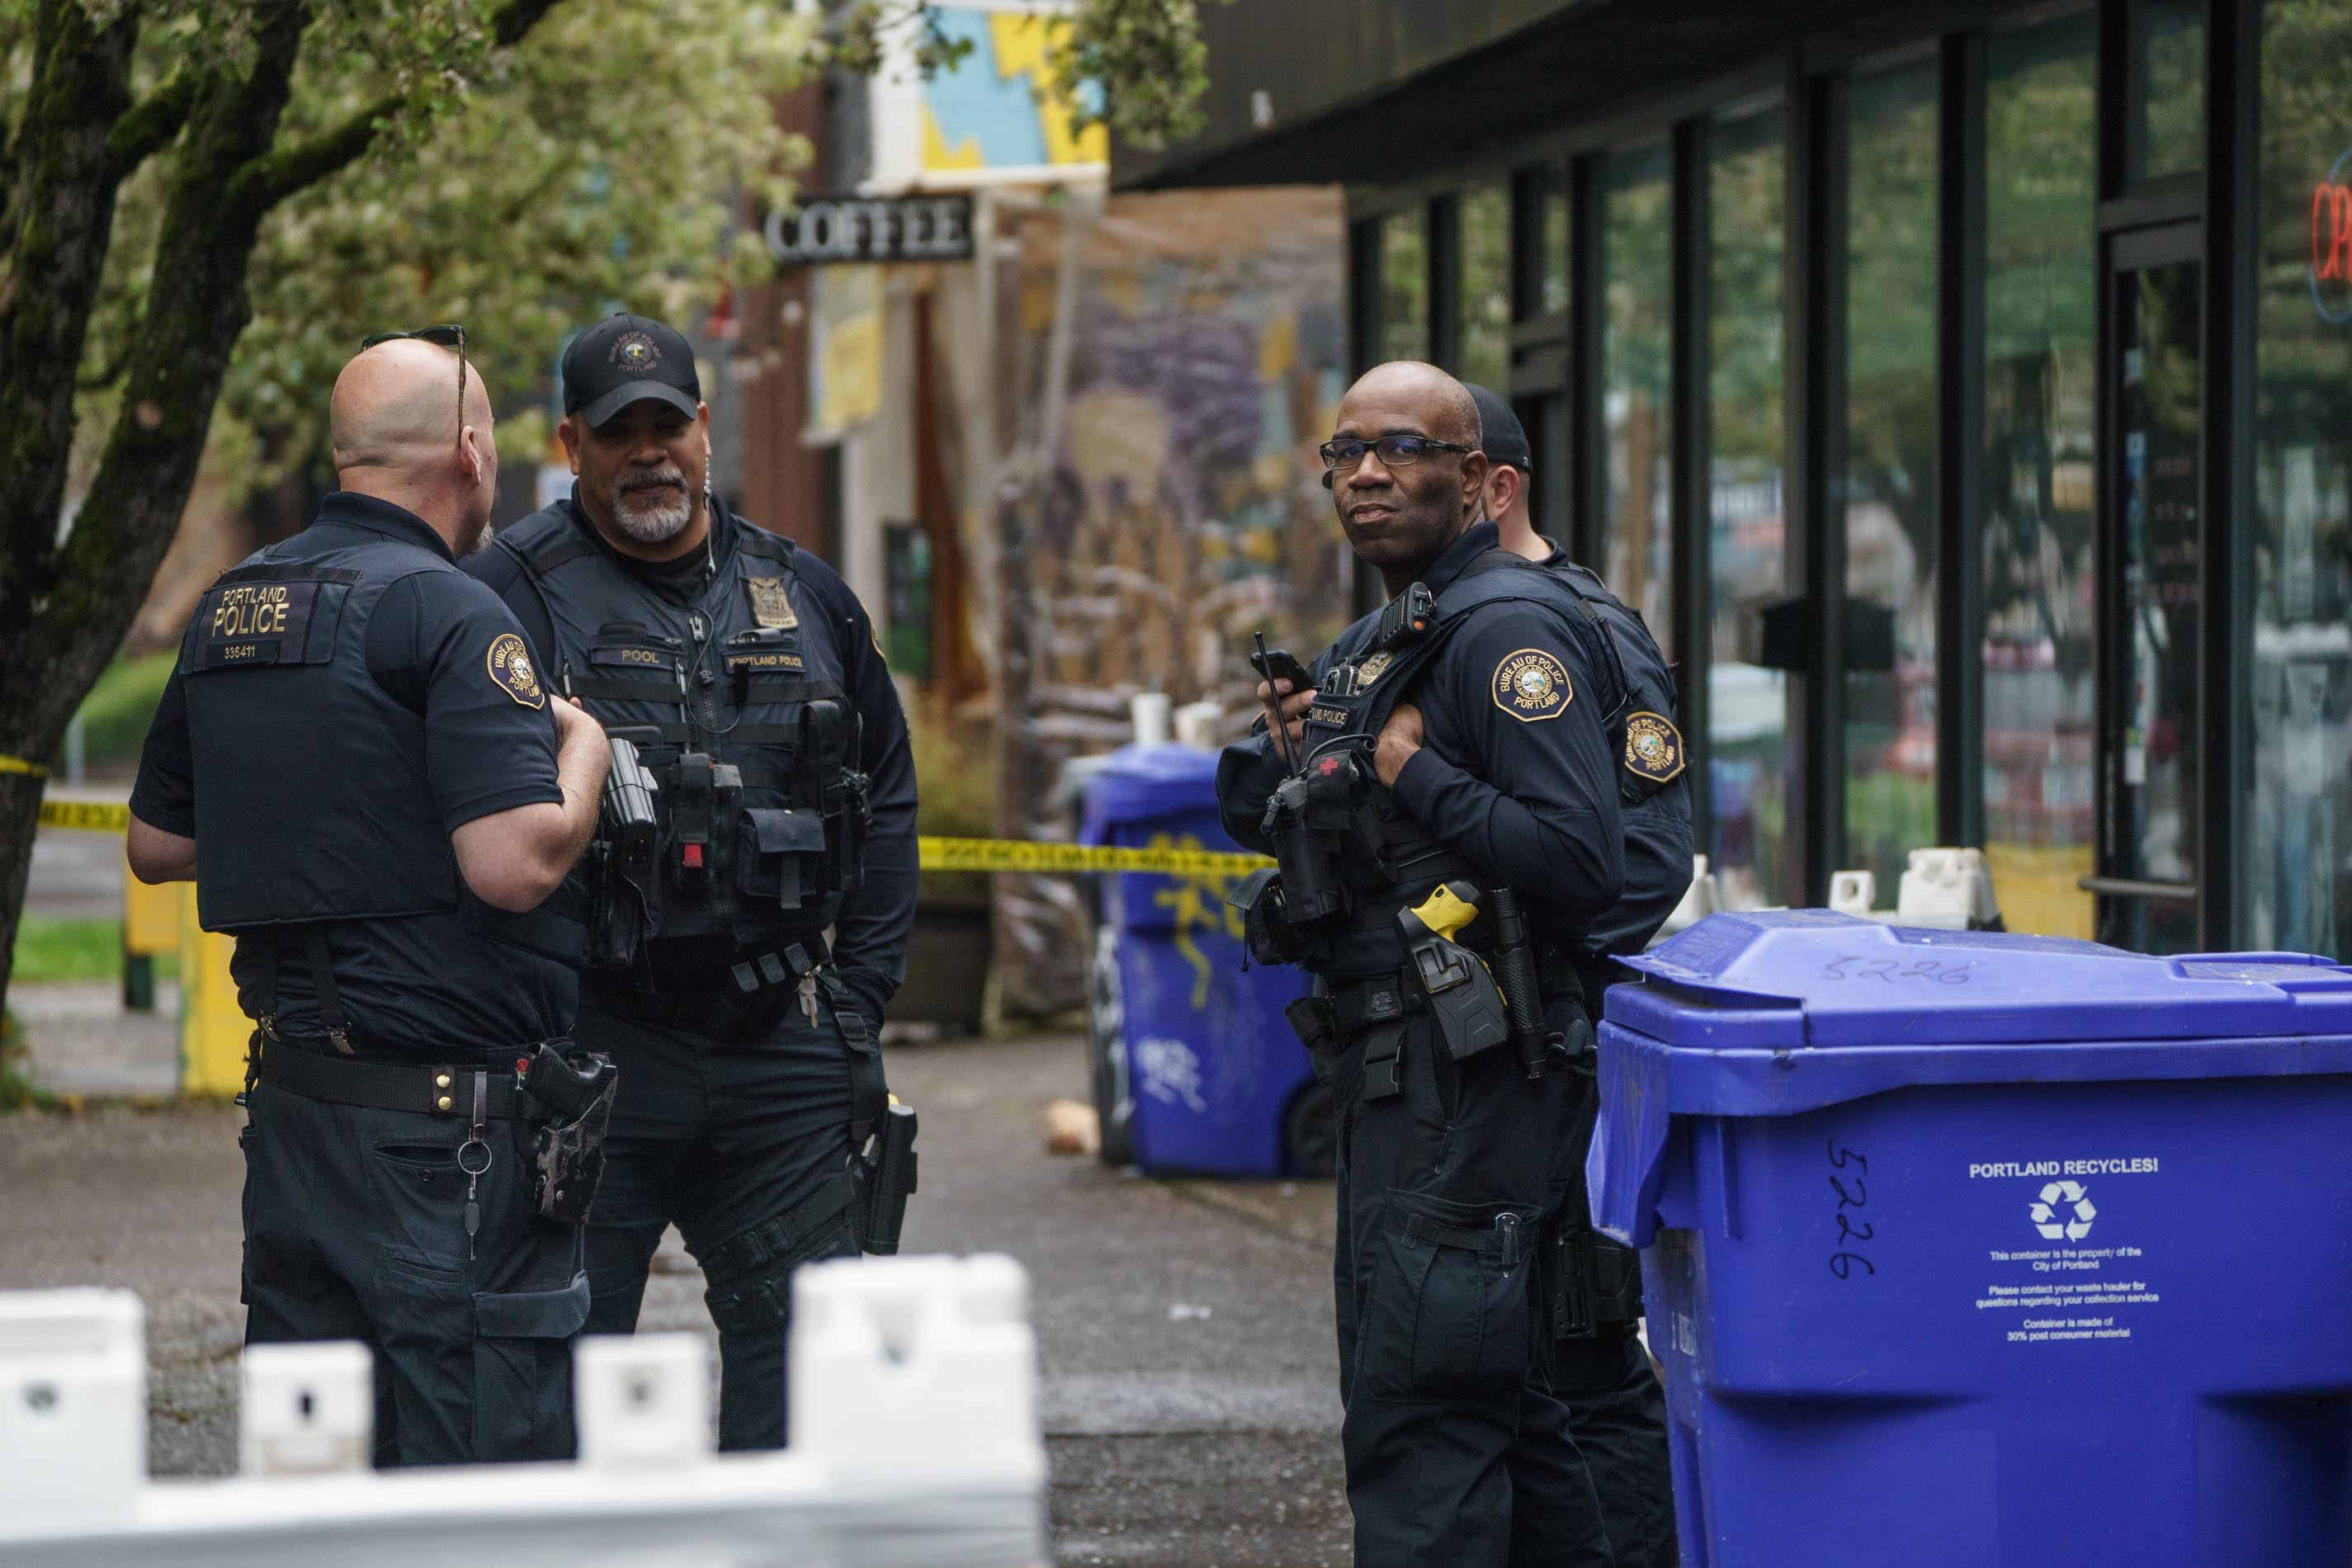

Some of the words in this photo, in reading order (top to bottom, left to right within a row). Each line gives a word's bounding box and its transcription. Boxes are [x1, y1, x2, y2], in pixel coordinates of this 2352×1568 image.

[765, 200, 967, 258] COFFEE
[222, 587, 287, 607] PORTLAND
[211, 603, 290, 637] POLICE
[224, 645, 256, 659] 336411
[495, 640, 515, 668] BUREAU
[622, 649, 659, 664] POOL
[779, 655, 802, 667] POLICE
[1500, 657, 1525, 692] BUREAU
[1525, 655, 1537, 665] OF
[1537, 657, 1565, 686] POLICE
[1514, 692, 1561, 709] PORTLAND
[1323, 710, 1347, 725] POLICE
[1641, 719, 1671, 738] POLICE
[1821, 956, 1970, 985] 5226
[1970, 1161, 2060, 1178] PORTLAND
[2064, 1158, 2159, 1174] RECYCLES!
[1827, 1137, 1875, 1280] 5226
[1990, 1251, 2010, 1260] This
[2010, 1251, 2052, 1260] container
[2052, 1250, 2062, 1259] is
[2062, 1249, 2077, 1259] the
[2078, 1249, 2114, 1259] property
[2116, 1248, 2126, 1257] of
[2126, 1247, 2142, 1257] the
[2033, 1261, 2050, 1273] City
[2052, 1261, 2062, 1271] of
[2062, 1260, 2099, 1270] Portland
[1989, 1285, 2020, 1296] Please
[2021, 1284, 2053, 1295] contact
[2054, 1284, 2075, 1295] your
[2076, 1283, 2103, 1292] waste
[2104, 1282, 2132, 1292] hauler
[2132, 1281, 2147, 1291] for
[1976, 1298, 2019, 1310] questions
[2020, 1296, 2062, 1307] regarding
[2063, 1296, 2083, 1306] your
[2084, 1294, 2126, 1304] collection
[2127, 1292, 2160, 1303] service
[2023, 1319, 2066, 1329] Container
[2067, 1318, 2076, 1328] is
[2076, 1318, 2103, 1328] made
[2104, 1317, 2114, 1327] of
[2007, 1331, 2028, 1342] 30%
[2028, 1331, 2049, 1342] post
[2050, 1330, 2094, 1340] consumer
[2095, 1328, 2131, 1339] material
